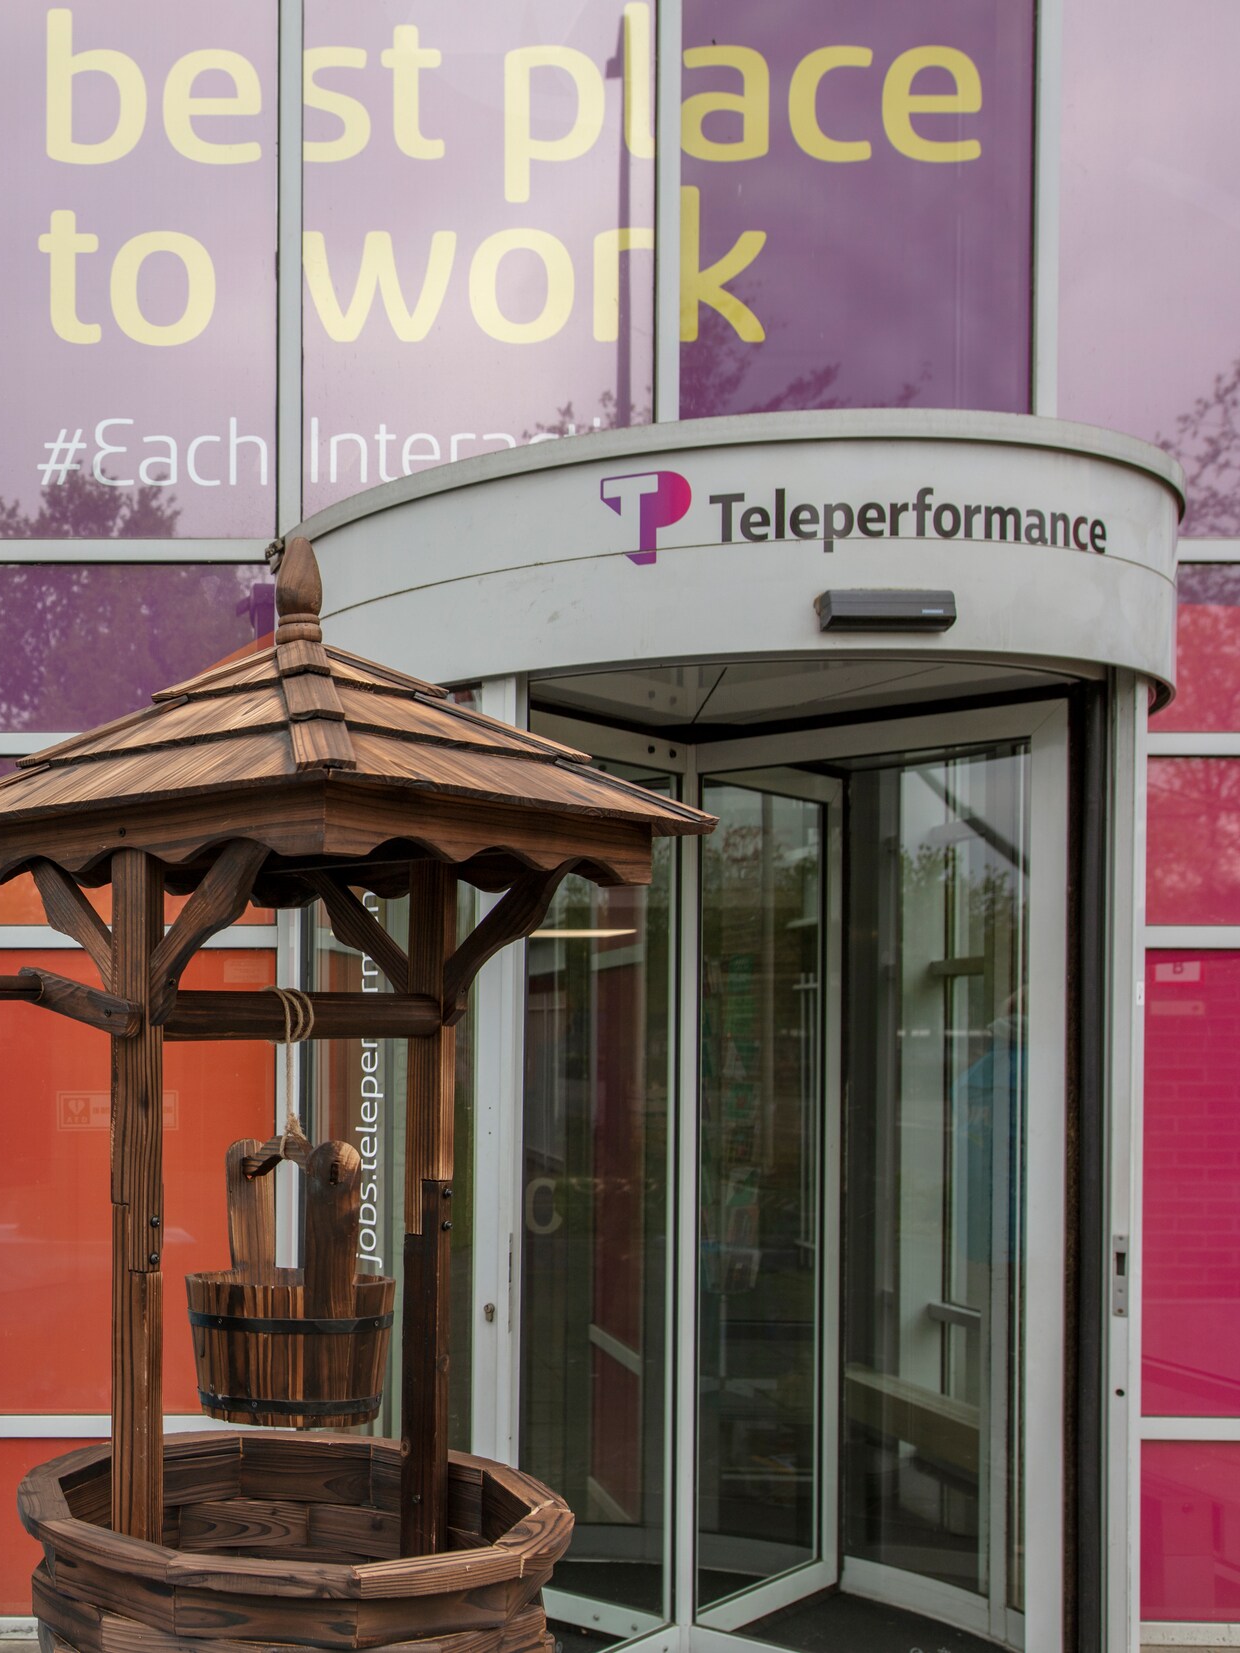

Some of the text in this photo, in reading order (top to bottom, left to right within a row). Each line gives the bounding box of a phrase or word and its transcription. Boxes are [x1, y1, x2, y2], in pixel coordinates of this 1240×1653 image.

[46, 2, 982, 202] best place
[38, 185, 767, 347] to work
[709, 487, 1107, 553] Teleperformance
